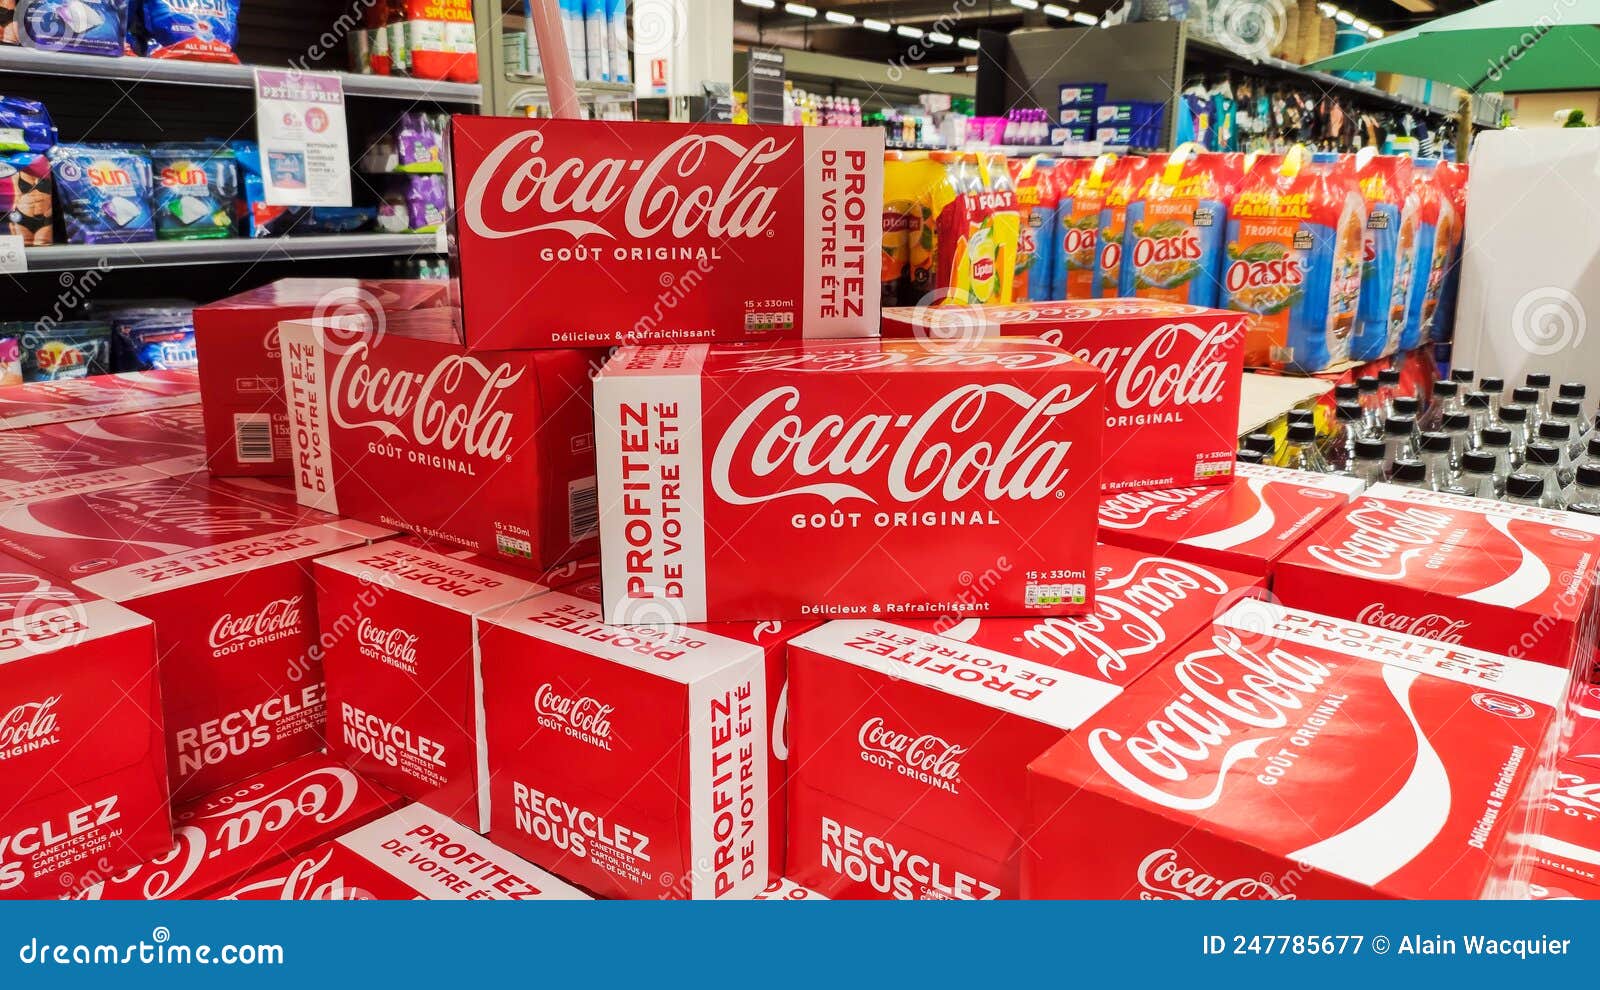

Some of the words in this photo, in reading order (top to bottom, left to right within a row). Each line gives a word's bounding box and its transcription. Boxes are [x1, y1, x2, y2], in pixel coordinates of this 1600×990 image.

[464, 130, 797, 240] Coca-Cola
[821, 150, 837, 183] DE
[821, 186, 837, 267] VOTRE
[1232, 204, 1312, 219] FAMILIAL
[1244, 224, 1294, 237] TROPICAL
[540, 244, 602, 261] GOÛT
[613, 247, 722, 261] ORIGINAL
[843, 150, 867, 318] PROFITEZ
[1133, 229, 1203, 268] Oasis
[1226, 253, 1303, 293] Oasis
[744, 300, 754, 308] 15
[764, 299, 794, 308] 330ml
[821, 274, 840, 319] ÉTÉ
[551, 331, 612, 342] Délicieux
[614, 331, 623, 340] &
[627, 328, 716, 339] Rafraîchissant
[302, 344, 316, 382] ÉTÉ
[288, 341, 313, 490] PROFITEZ
[330, 341, 527, 460] Coca-Cola
[1106, 411, 1184, 428] ORIGINAL
[308, 391, 322, 458] VOTRE
[653, 402, 680, 455] ÉTÉ
[711, 382, 1097, 506] Coca-Cola
[314, 466, 326, 494] DE
[368, 441, 402, 460] GOÛT
[408, 450, 476, 476] ORIGINAL
[620, 402, 655, 599] PROFITEZ
[660, 465, 683, 556] VOTRE
[791, 510, 861, 529] GOÛT
[874, 510, 1000, 528] ORIGINAL
[142, 538, 321, 582] PROFITEZ
[356, 556, 482, 598] PROFITEZ
[664, 564, 684, 599] DE
[1025, 571, 1038, 580] 15
[1049, 569, 1086, 579] 330ml
[208, 594, 304, 649] Coca-Cola
[801, 603, 867, 615] Délicieux
[872, 603, 882, 613] &
[886, 601, 990, 613] Rafraîchissant
[1356, 602, 1472, 643] Coca-Cola
[212, 639, 245, 659] GOÛT
[248, 626, 302, 649] ORIGINAL
[357, 616, 420, 665] Coca-Cola
[528, 611, 686, 661] PROFITEZ
[1272, 622, 1311, 638] DE
[1322, 636, 1423, 664] VOTRE
[1280, 614, 1505, 673] PROFITEZ
[360, 645, 380, 661] GOÛT
[381, 655, 418, 676] ORIGINAL
[842, 635, 1044, 701] PROFITEZ
[938, 646, 1010, 673] VOTRE
[1013, 668, 1058, 687] DE
[534, 683, 615, 739] Coca-Cola
[735, 681, 751, 738] ÉTÉ
[1088, 628, 1331, 811] Coca-Cola
[179, 724, 271, 776] NOUS
[341, 701, 447, 768] RECYCLEZ
[343, 724, 398, 768] NOUS
[537, 715, 563, 731] GOÛT
[564, 727, 613, 752] ORIGINAL
[858, 716, 968, 780] Coca-Cola
[1256, 748, 1300, 786] GOÛT
[1289, 691, 1348, 747] ORIGINAL
[711, 690, 735, 900] PROFITEZ
[740, 743, 754, 833] VOTRE
[860, 751, 894, 771] GOÛT
[897, 763, 959, 795] ORIGINAL
[513, 781, 651, 862] RECYCLEZ
[515, 805, 587, 858] NOUS
[31, 836, 86, 861] CANETTES
[86, 829, 101, 840] ET
[32, 847, 80, 869] CARTON,
[81, 836, 108, 851] TOUS
[109, 828, 124, 838] AU
[33, 865, 56, 879] BAC
[56, 861, 71, 871] DE
[72, 853, 89, 864] DE
[380, 838, 413, 858] DE
[408, 853, 473, 894] VOTRE
[405, 824, 543, 900] PROFITEZ
[742, 839, 754, 881] DE
[821, 816, 1001, 900] RECYCLEZ
[822, 843, 914, 900] NOUS
